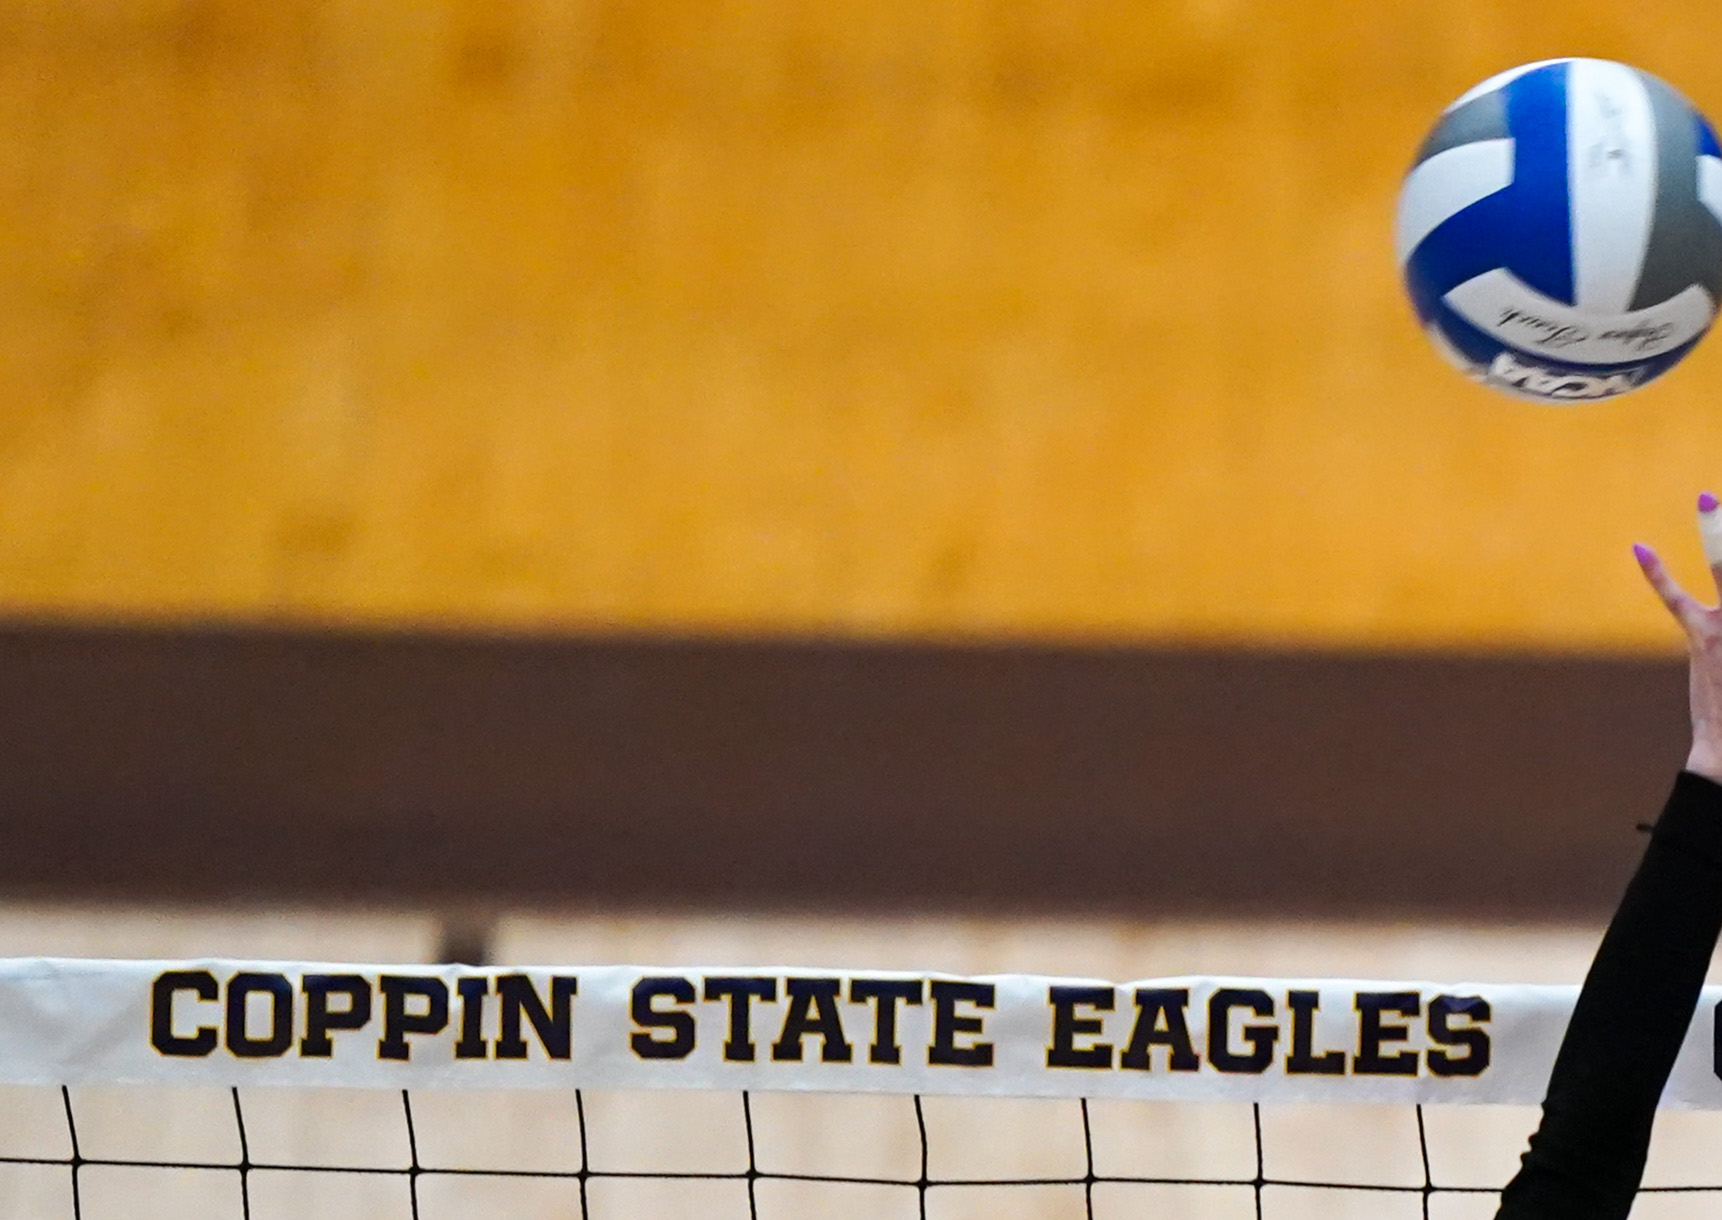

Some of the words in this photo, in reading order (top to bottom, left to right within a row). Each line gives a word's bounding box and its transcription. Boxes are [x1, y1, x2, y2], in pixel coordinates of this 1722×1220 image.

[149, 969, 578, 1060] COPPIN
[628, 975, 995, 1067] STATE
[1045, 986, 1491, 1077] EAGLES
